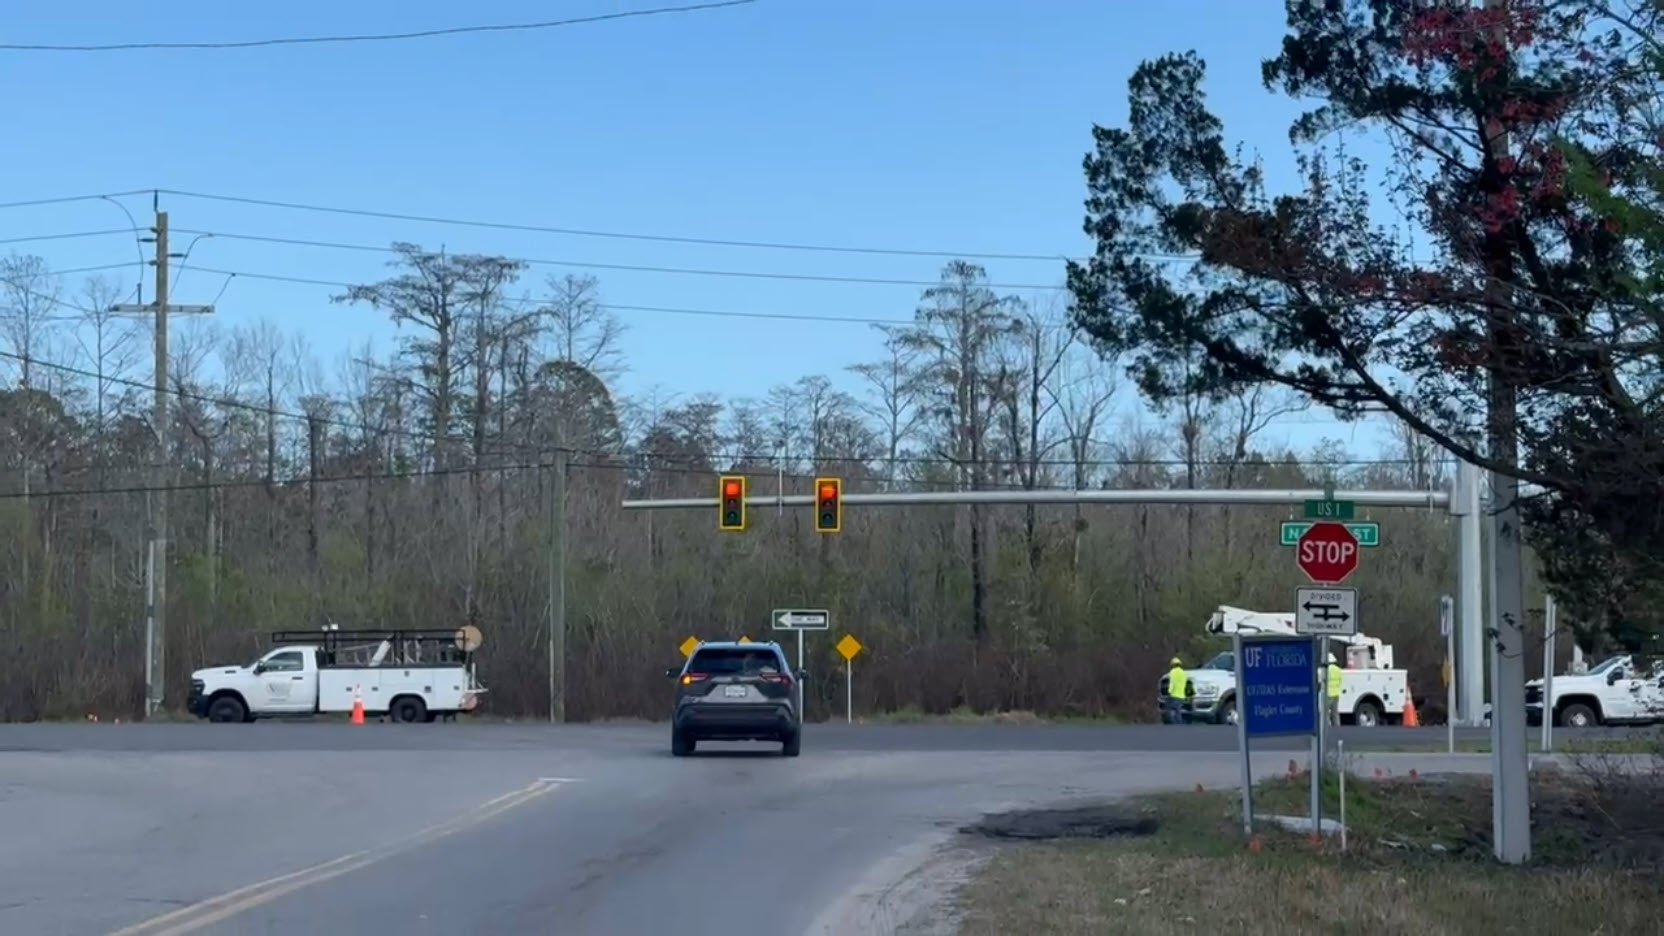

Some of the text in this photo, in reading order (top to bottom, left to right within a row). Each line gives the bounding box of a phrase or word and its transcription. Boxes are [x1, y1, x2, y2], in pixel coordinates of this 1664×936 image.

[1317, 503, 1331, 516] US
[1354, 529, 1371, 540] ST
[1302, 541, 1354, 564] STOP
[1310, 592, 1342, 600] DIVIDED
[1245, 647, 1262, 667] UF
[1267, 653, 1307, 667] FLORIDA
